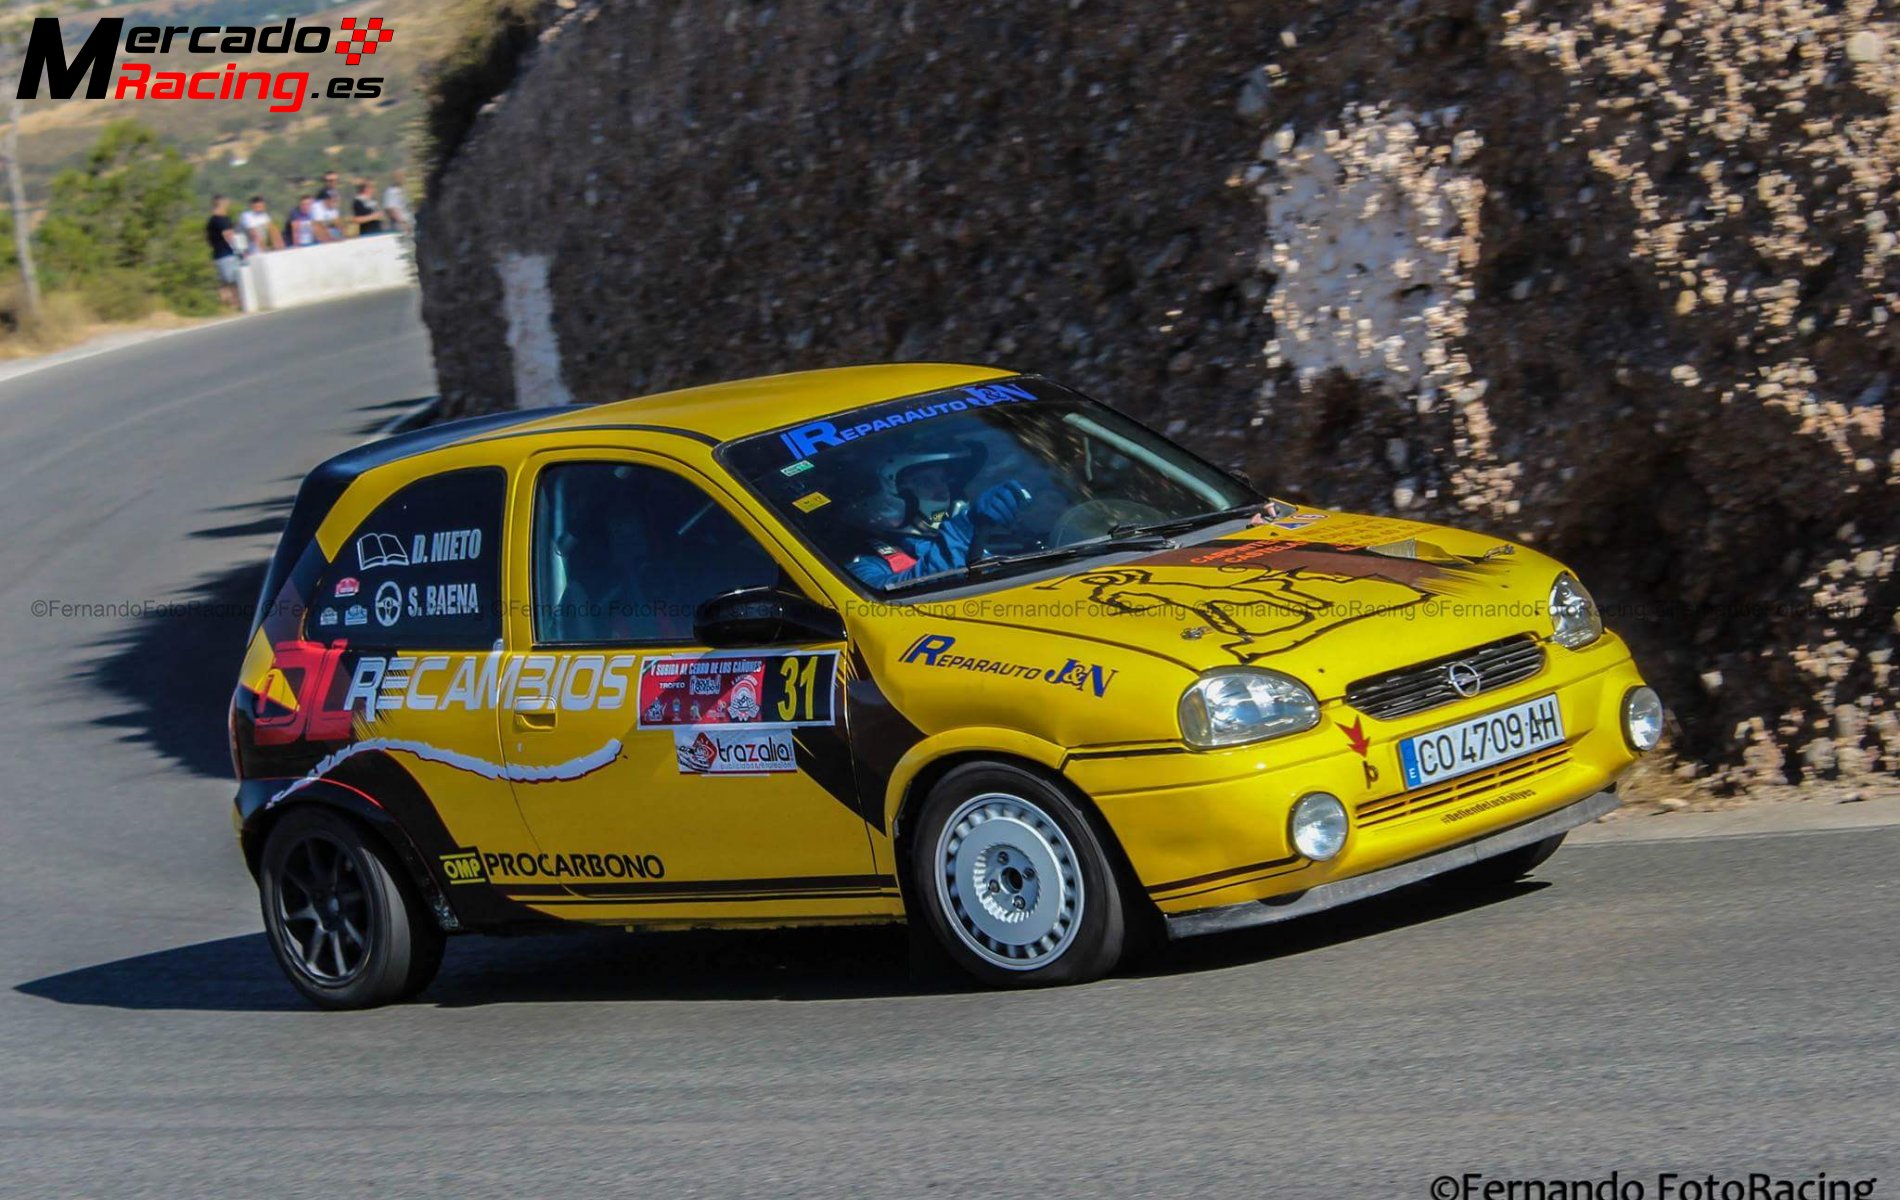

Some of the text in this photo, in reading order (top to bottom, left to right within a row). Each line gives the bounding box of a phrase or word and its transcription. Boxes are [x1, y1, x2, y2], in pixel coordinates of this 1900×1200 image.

[780, 400, 968, 460] REPARAUTO
[411, 528, 482, 564] D. NIETO
[408, 587, 423, 617] S.
[426, 583, 479, 615] BAENA
[656, 663, 679, 676] SUBIDA
[898, 634, 1120, 698] REPARAUTO J&N
[344, 655, 636, 722] RECAMBIOS
[659, 681, 686, 689] TROFEO
[777, 656, 818, 721] 31
[716, 737, 790, 762] trazalia
[1418, 701, 1559, 776] CO 4709 AH
[1409, 767, 1418, 779] E
[443, 852, 666, 880] OMP PROCARBONO
